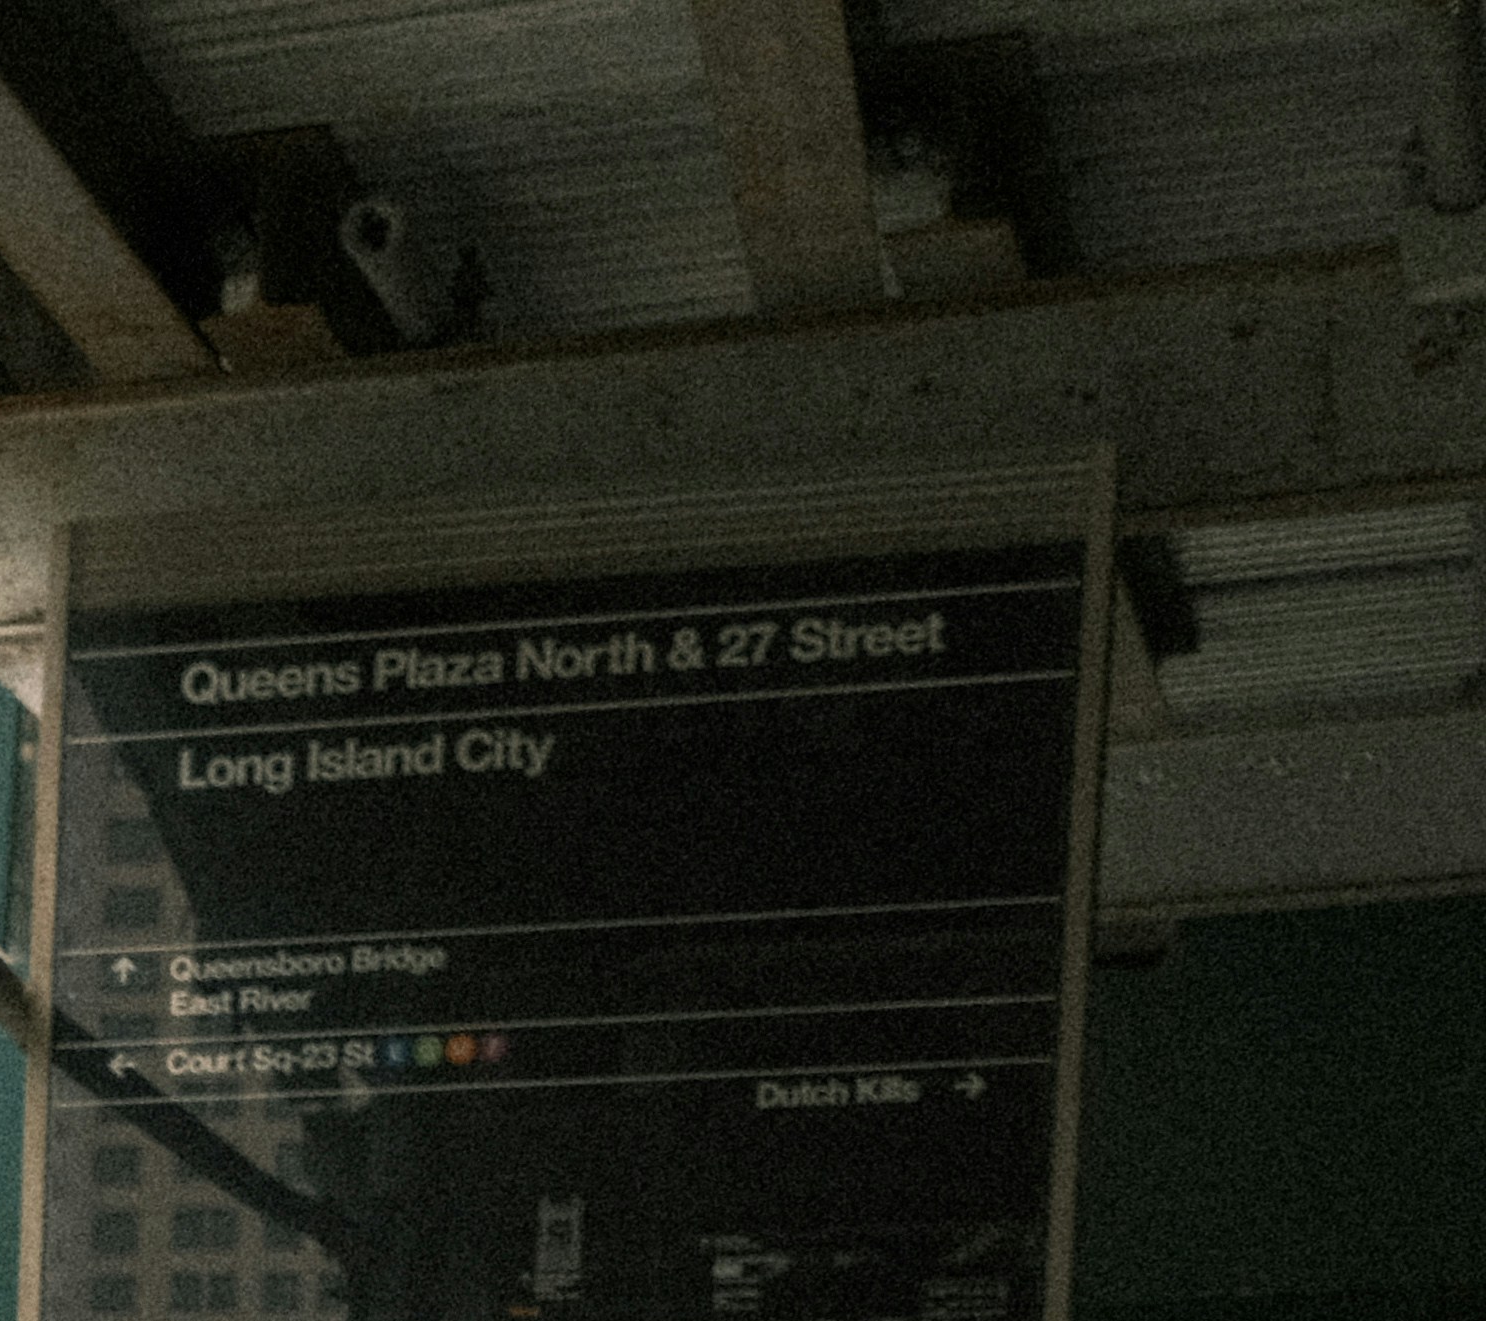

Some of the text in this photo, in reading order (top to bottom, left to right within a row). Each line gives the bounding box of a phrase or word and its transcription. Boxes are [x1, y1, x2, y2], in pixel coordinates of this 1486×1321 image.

[181, 612, 946, 705] Queens Plaza North & 27 Street
[178, 728, 553, 793] Long Island City
[169, 945, 446, 982] Queensboro Bridge
[170, 986, 315, 1016] East River
[166, 1048, 244, 1075] Court
[756, 1074, 922, 1109] Dutch Kills
